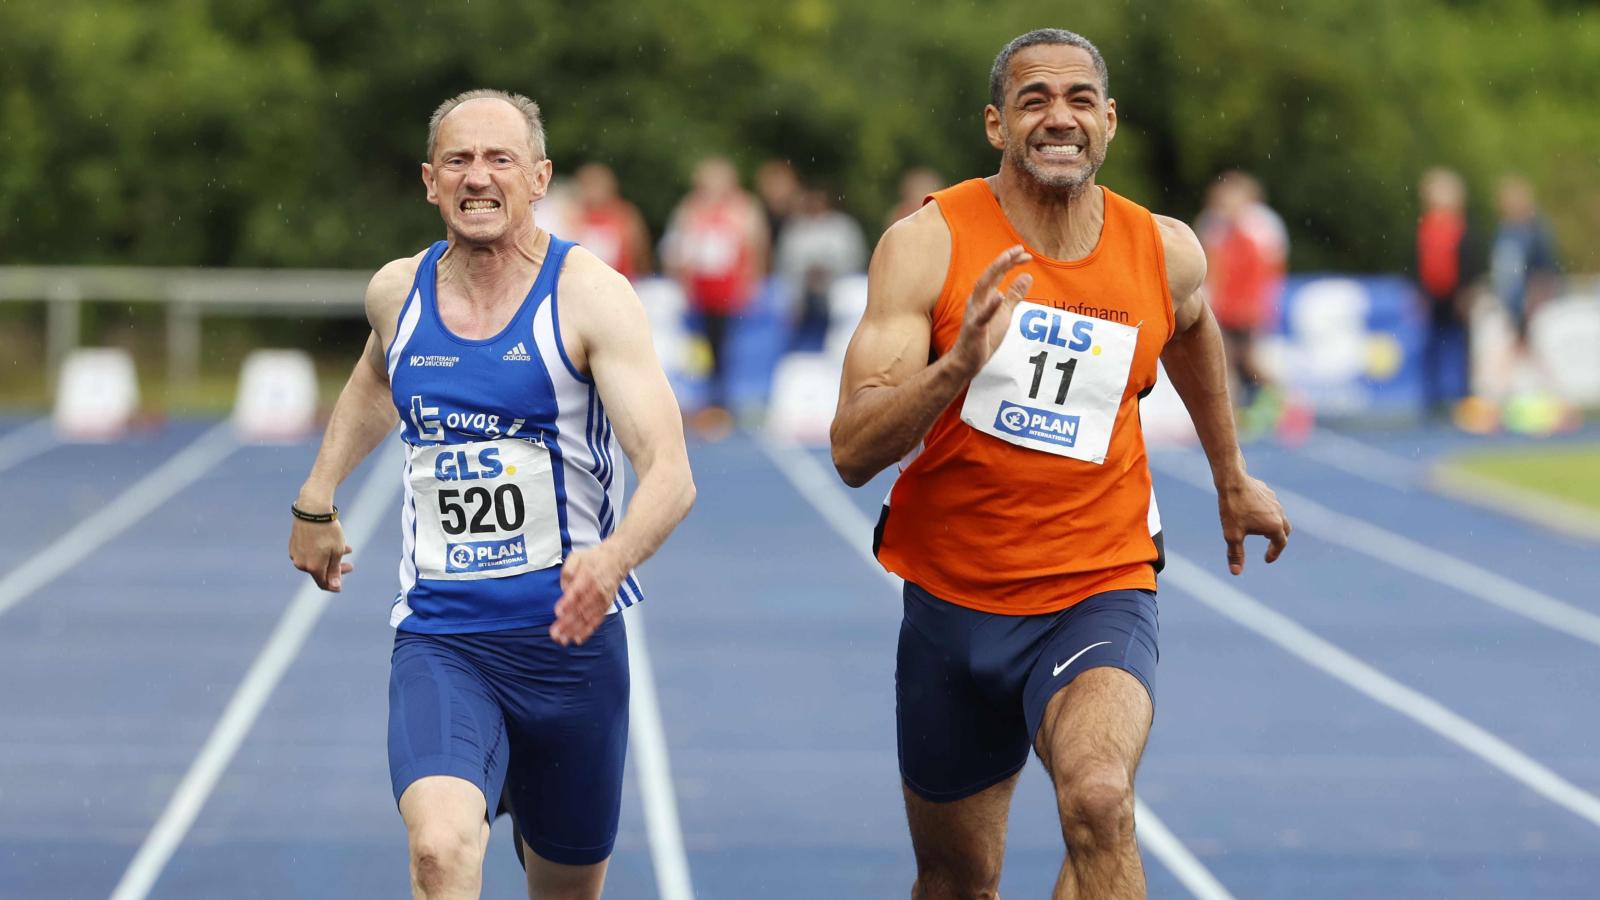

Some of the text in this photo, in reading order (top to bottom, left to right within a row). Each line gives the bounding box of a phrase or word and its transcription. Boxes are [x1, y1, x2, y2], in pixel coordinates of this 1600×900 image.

[1054, 300, 1129, 323] Hofmann
[503, 353, 531, 361] adidas
[1028, 351, 1078, 405] 11
[446, 413, 500, 435] ovag
[1030, 414, 1076, 436] PLAN
[1028, 429, 1073, 443] INTERNATIONAL
[438, 483, 526, 535] 520
[476, 541, 523, 561] PLAN
[477, 556, 525, 568] INTERNATIONAL
